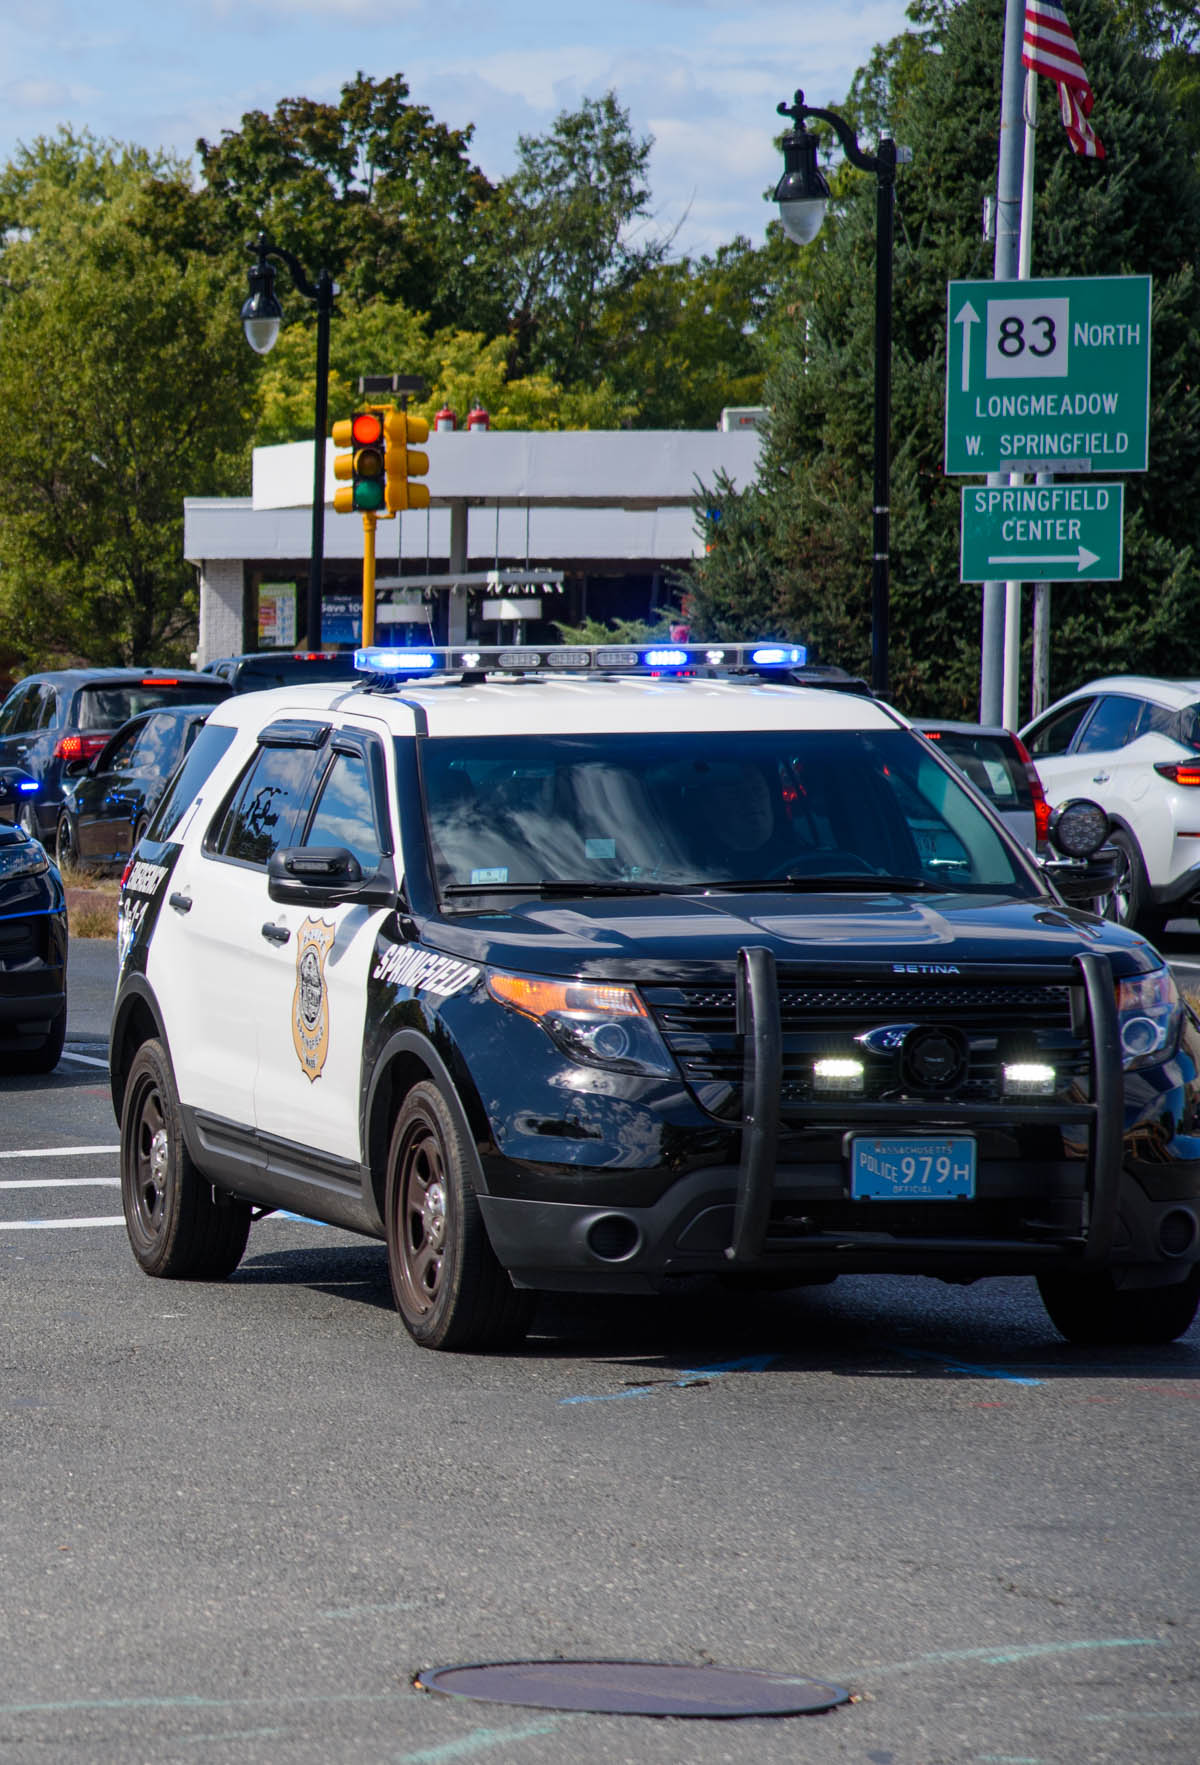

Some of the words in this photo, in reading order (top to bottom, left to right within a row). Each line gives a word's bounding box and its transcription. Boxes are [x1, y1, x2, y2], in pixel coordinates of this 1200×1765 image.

[997, 315, 1057, 358] 83
[1073, 322, 1141, 347] NORTH
[975, 393, 1119, 418] LONGMEADOW
[965, 434, 984, 456] W.
[999, 432, 1129, 456] SPRINGFIELD
[974, 489, 1109, 513] SPRINGFIELD
[1001, 519, 1081, 541] CENTER
[373, 943, 481, 996] SPRINGFIELD
[892, 963, 961, 974] SETINA
[860, 1152, 898, 1183] POLICE
